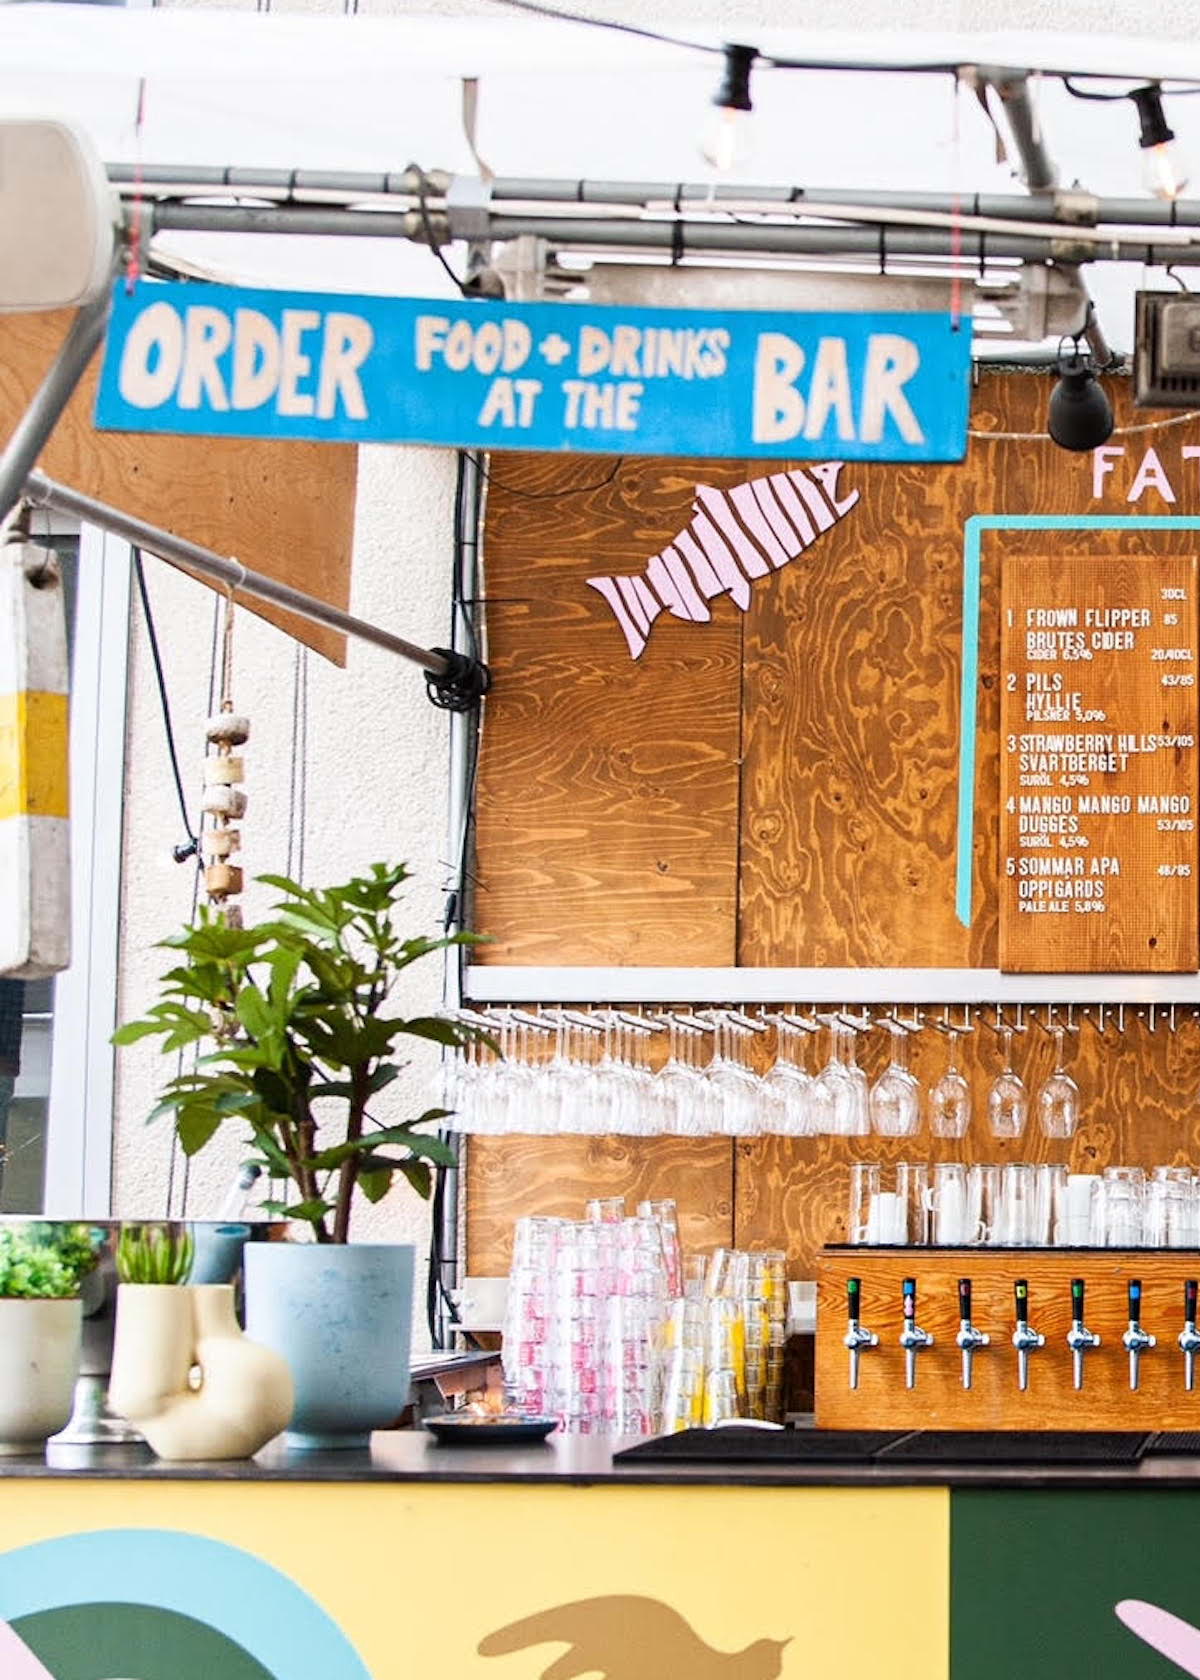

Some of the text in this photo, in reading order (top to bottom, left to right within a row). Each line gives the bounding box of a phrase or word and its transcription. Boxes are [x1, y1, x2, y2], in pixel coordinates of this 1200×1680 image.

[415, 315, 532, 375] FOOD
[578, 325, 731, 379] DRINKS
[118, 301, 374, 420] ORDER
[752, 332, 926, 445] BAR
[477, 377, 645, 430] AT THE
[1007, 609, 1013, 627] 1
[1027, 609, 1078, 627] FROWN
[1085, 609, 1151, 627] FLIPPER
[1027, 632, 1135, 650] BRUTES CIDER
[1027, 650, 1057, 660] CIDER
[1007, 674, 1016, 692] 2
[1027, 673, 1063, 691] PILS
[1027, 693, 1082, 711] HYLLIE
[1027, 711, 1070, 721] PILSNER
[1007, 735, 1016, 751] 3
[1020, 735, 1113, 752] STRAWBERRY
[1118, 735, 1157, 752] HILLS
[1020, 754, 1129, 772] SVARTBERGET
[1006, 797, 1189, 814] 4 MANGO MANGO MANGO
[1019, 816, 1078, 833] DUGGES
[1006, 858, 1015, 875] 5
[1019, 858, 1084, 876] SOMMAR
[1091, 858, 1120, 876] APA
[1019, 876, 1104, 898] OPPIGÅRDS
[1019, 902, 1047, 912] PALE
[1048, 902, 1069, 912] ALE
